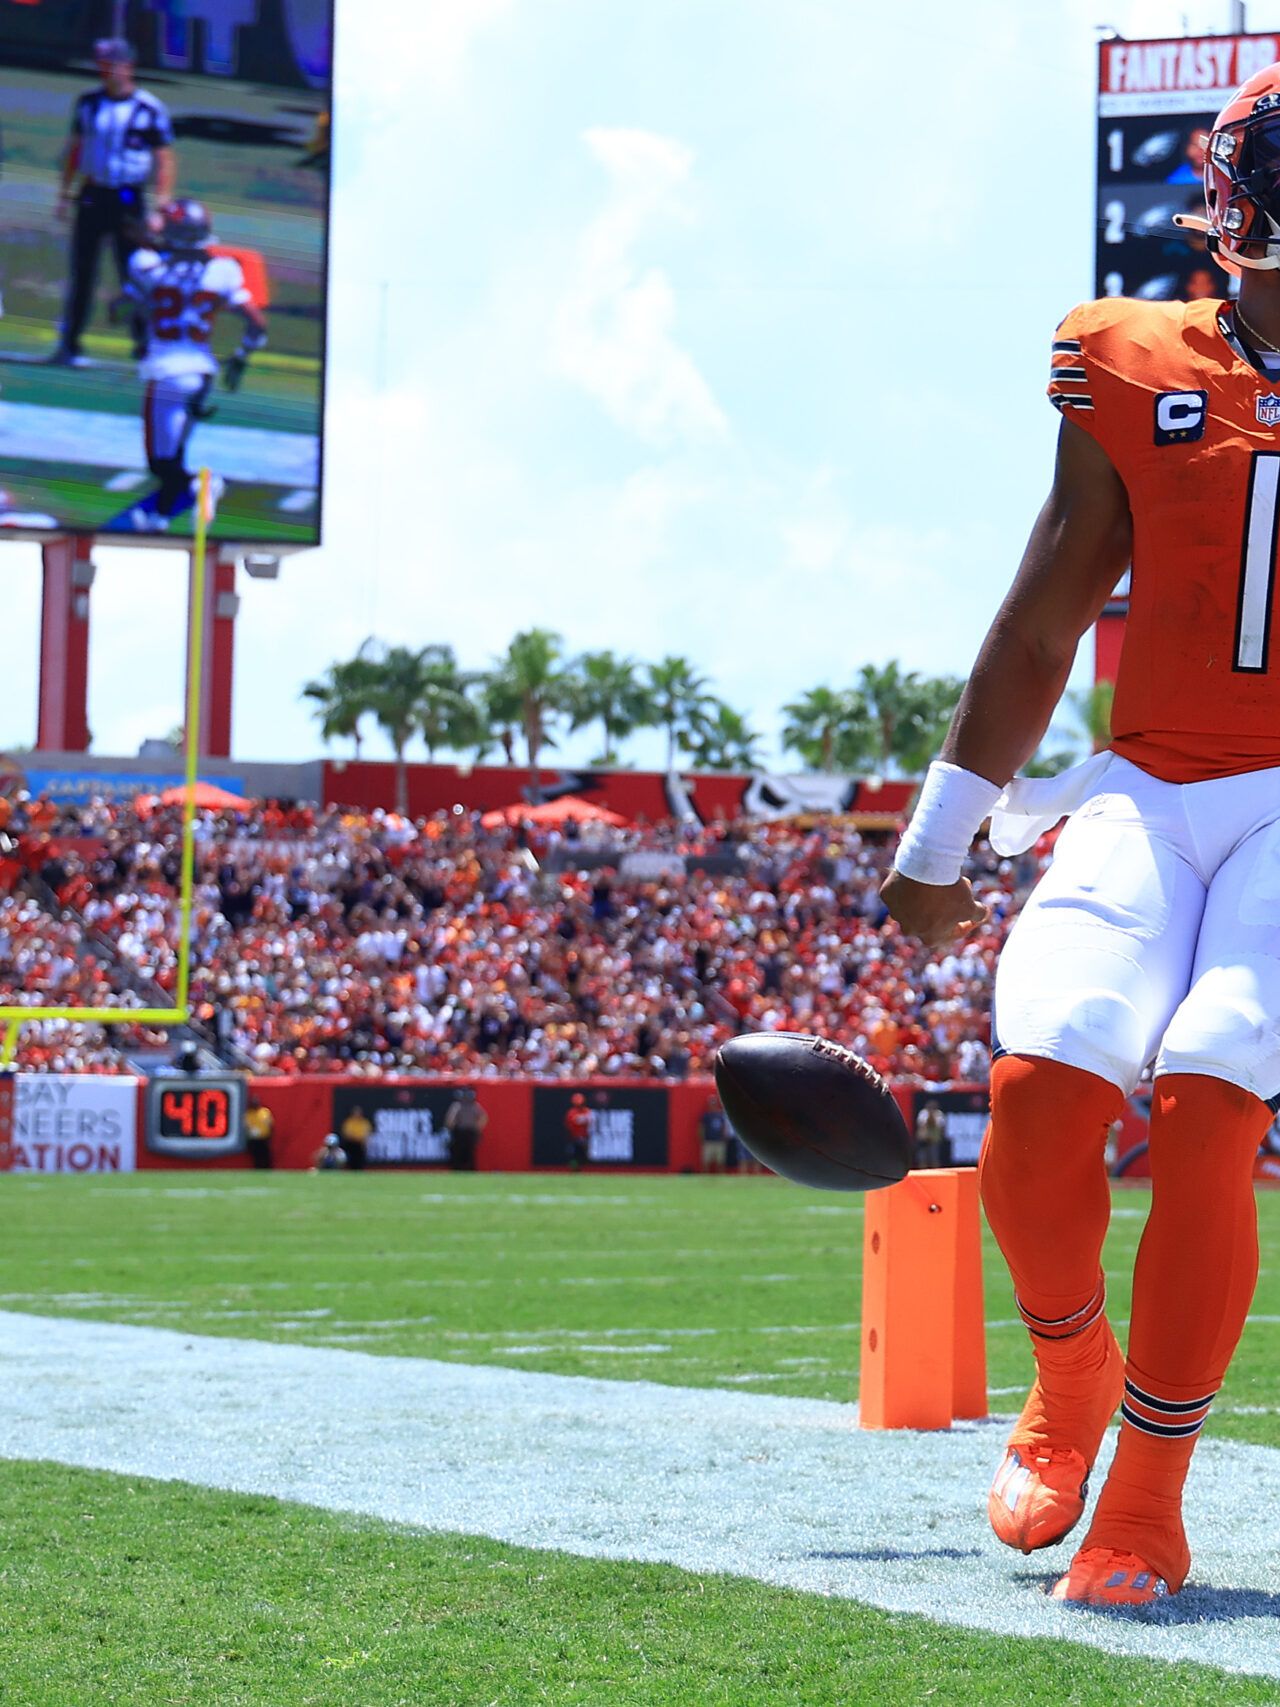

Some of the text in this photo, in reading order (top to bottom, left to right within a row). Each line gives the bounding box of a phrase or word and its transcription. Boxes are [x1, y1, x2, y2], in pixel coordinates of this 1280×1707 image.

[1108, 39, 1234, 94] FANTASY
[1107, 128, 1124, 173] 1
[1104, 200, 1126, 244] 2
[1157, 393, 1203, 431] C
[1260, 406, 1280, 419] NFL
[163, 1089, 228, 1138] 40
